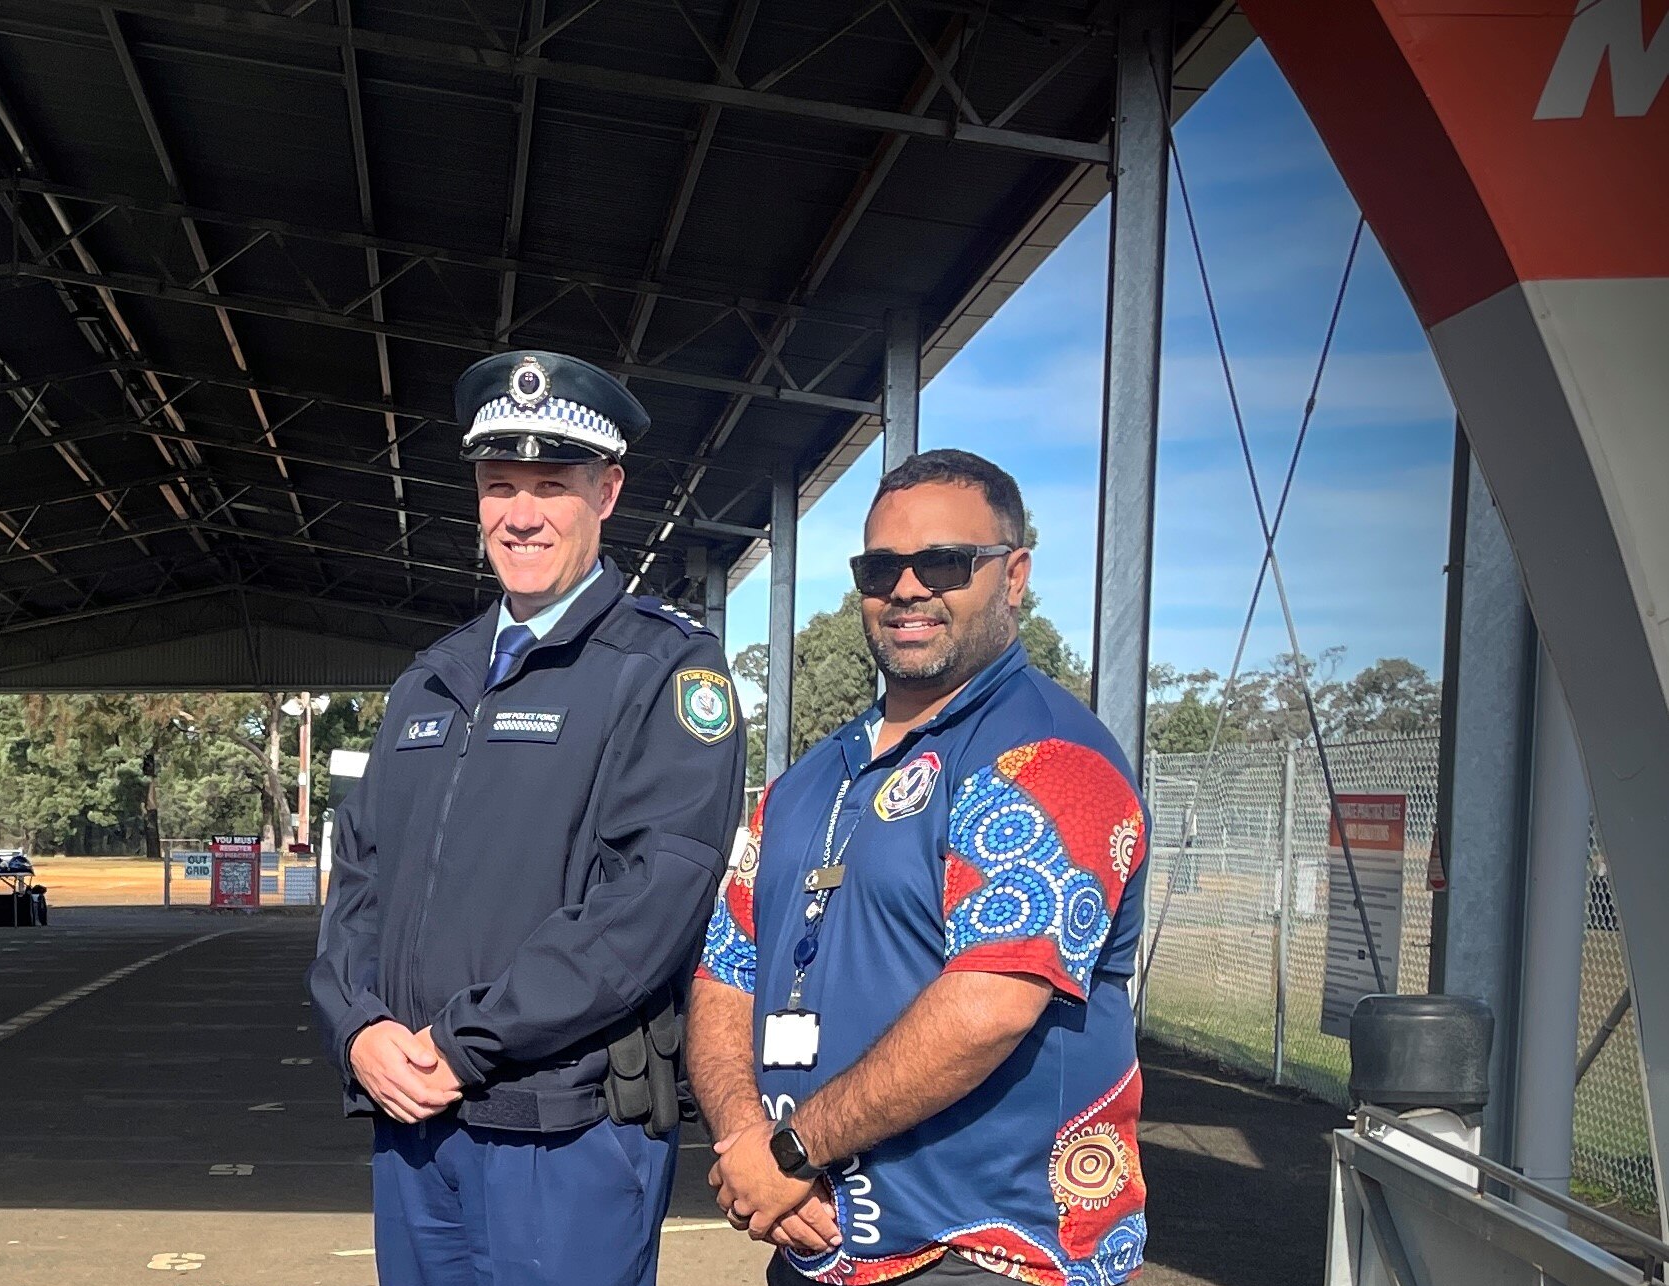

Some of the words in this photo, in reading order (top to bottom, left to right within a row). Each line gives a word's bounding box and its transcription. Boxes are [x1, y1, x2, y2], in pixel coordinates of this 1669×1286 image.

[512, 712, 537, 721] POLICE
[536, 713, 561, 723] FORCE
[214, 836, 232, 845] YOU
[233, 836, 258, 846] MUST
[187, 855, 208, 865] OUT
[185, 865, 210, 876] GRID
